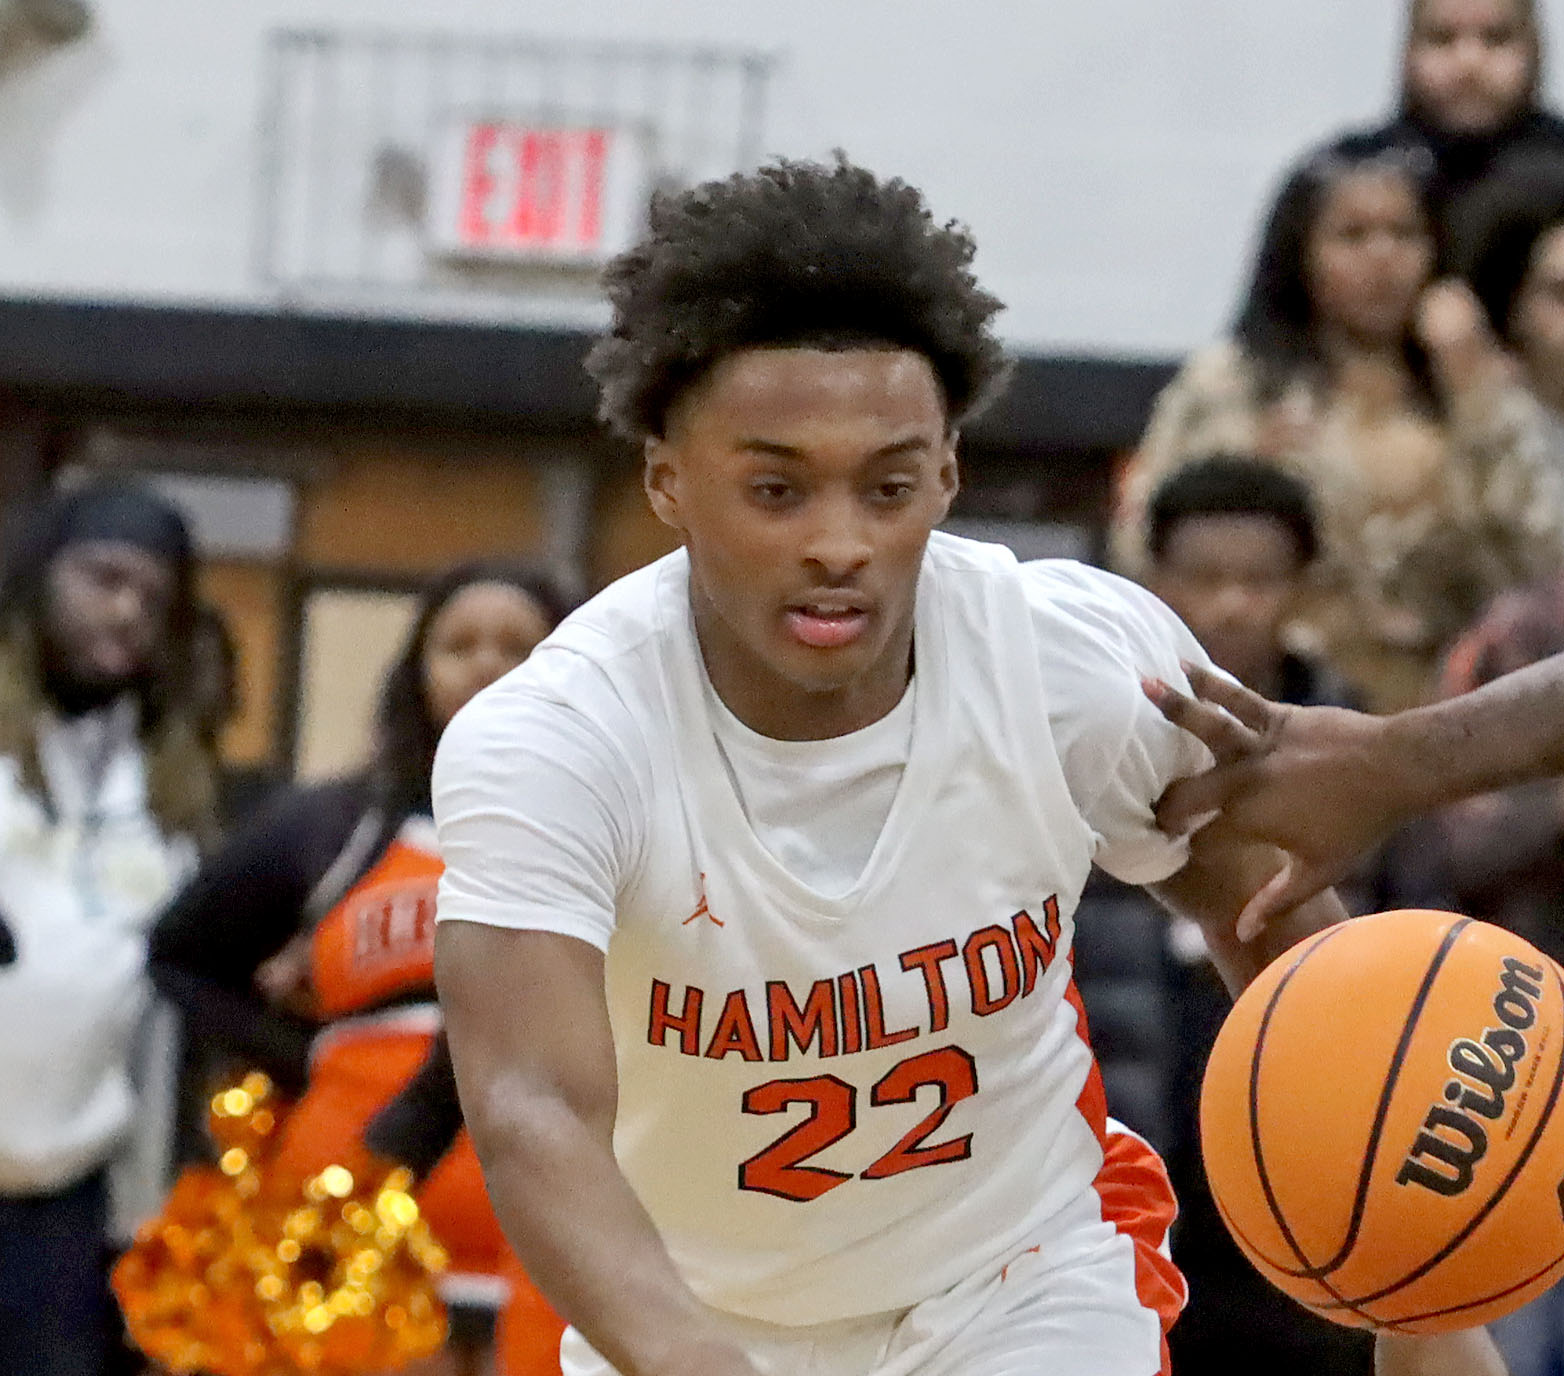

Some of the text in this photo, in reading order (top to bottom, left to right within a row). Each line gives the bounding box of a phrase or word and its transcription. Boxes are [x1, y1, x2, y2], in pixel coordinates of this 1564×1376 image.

[457, 122, 611, 247] EXIT
[647, 893, 1061, 1062] HAMILTON
[737, 1044, 979, 1203] 22
[1394, 955, 1545, 1198] Wilson
